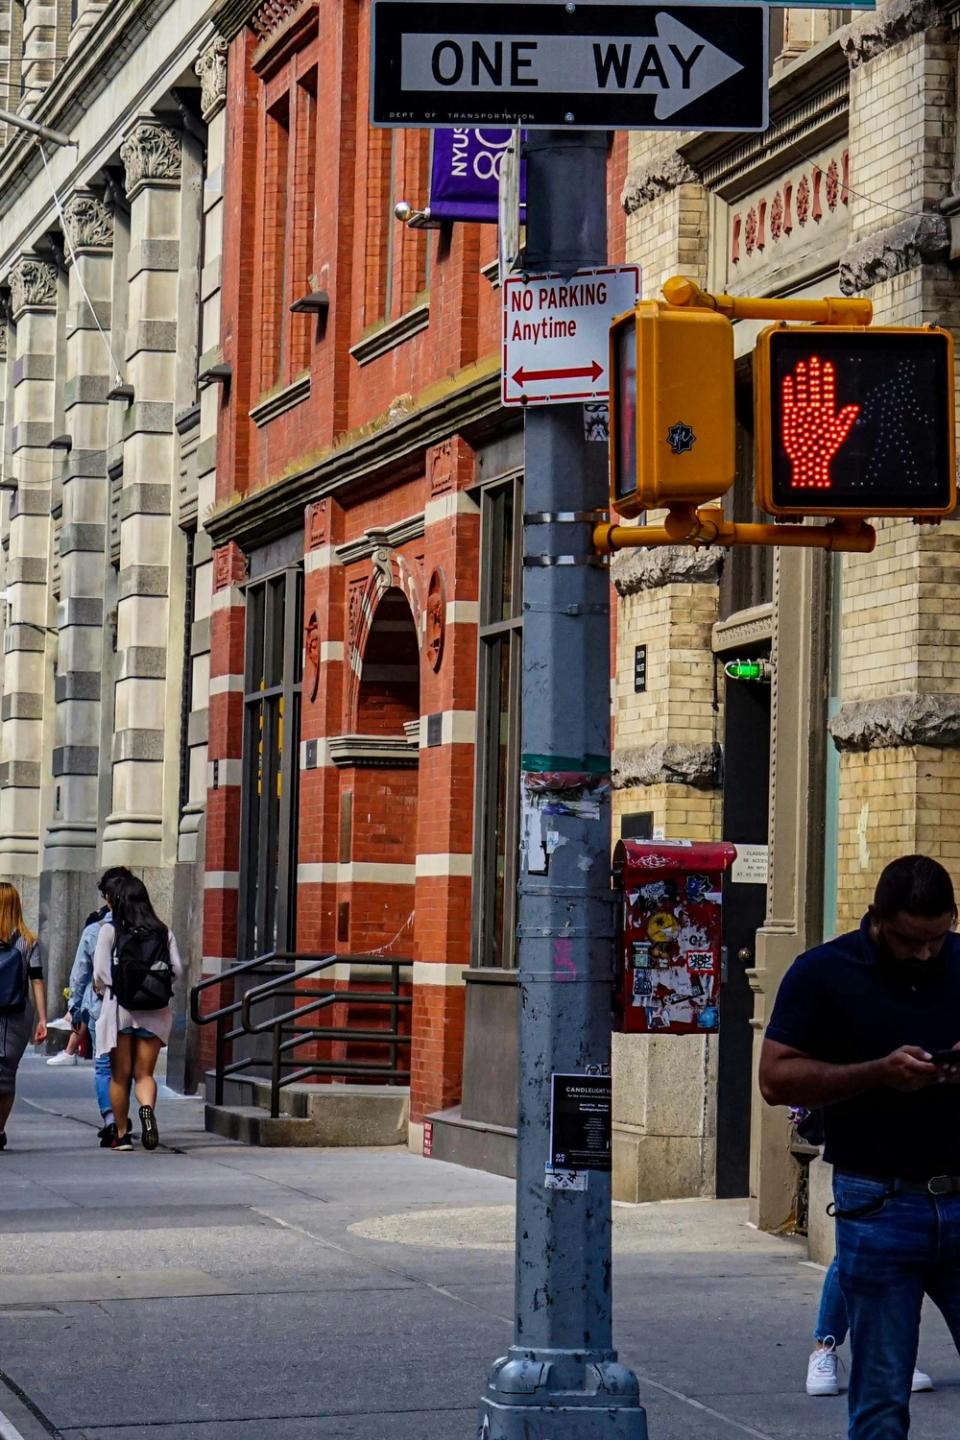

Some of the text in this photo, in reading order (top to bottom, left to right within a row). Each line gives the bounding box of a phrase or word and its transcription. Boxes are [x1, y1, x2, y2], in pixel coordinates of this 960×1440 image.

[431, 40, 705, 89] ONE WAY
[448, 112, 535, 120] TRANSPORTATION
[512, 282, 607, 312] NO PARKING
[512, 317, 577, 345] Anytime
[566, 1086, 606, 1094] CANDLELIGHT
